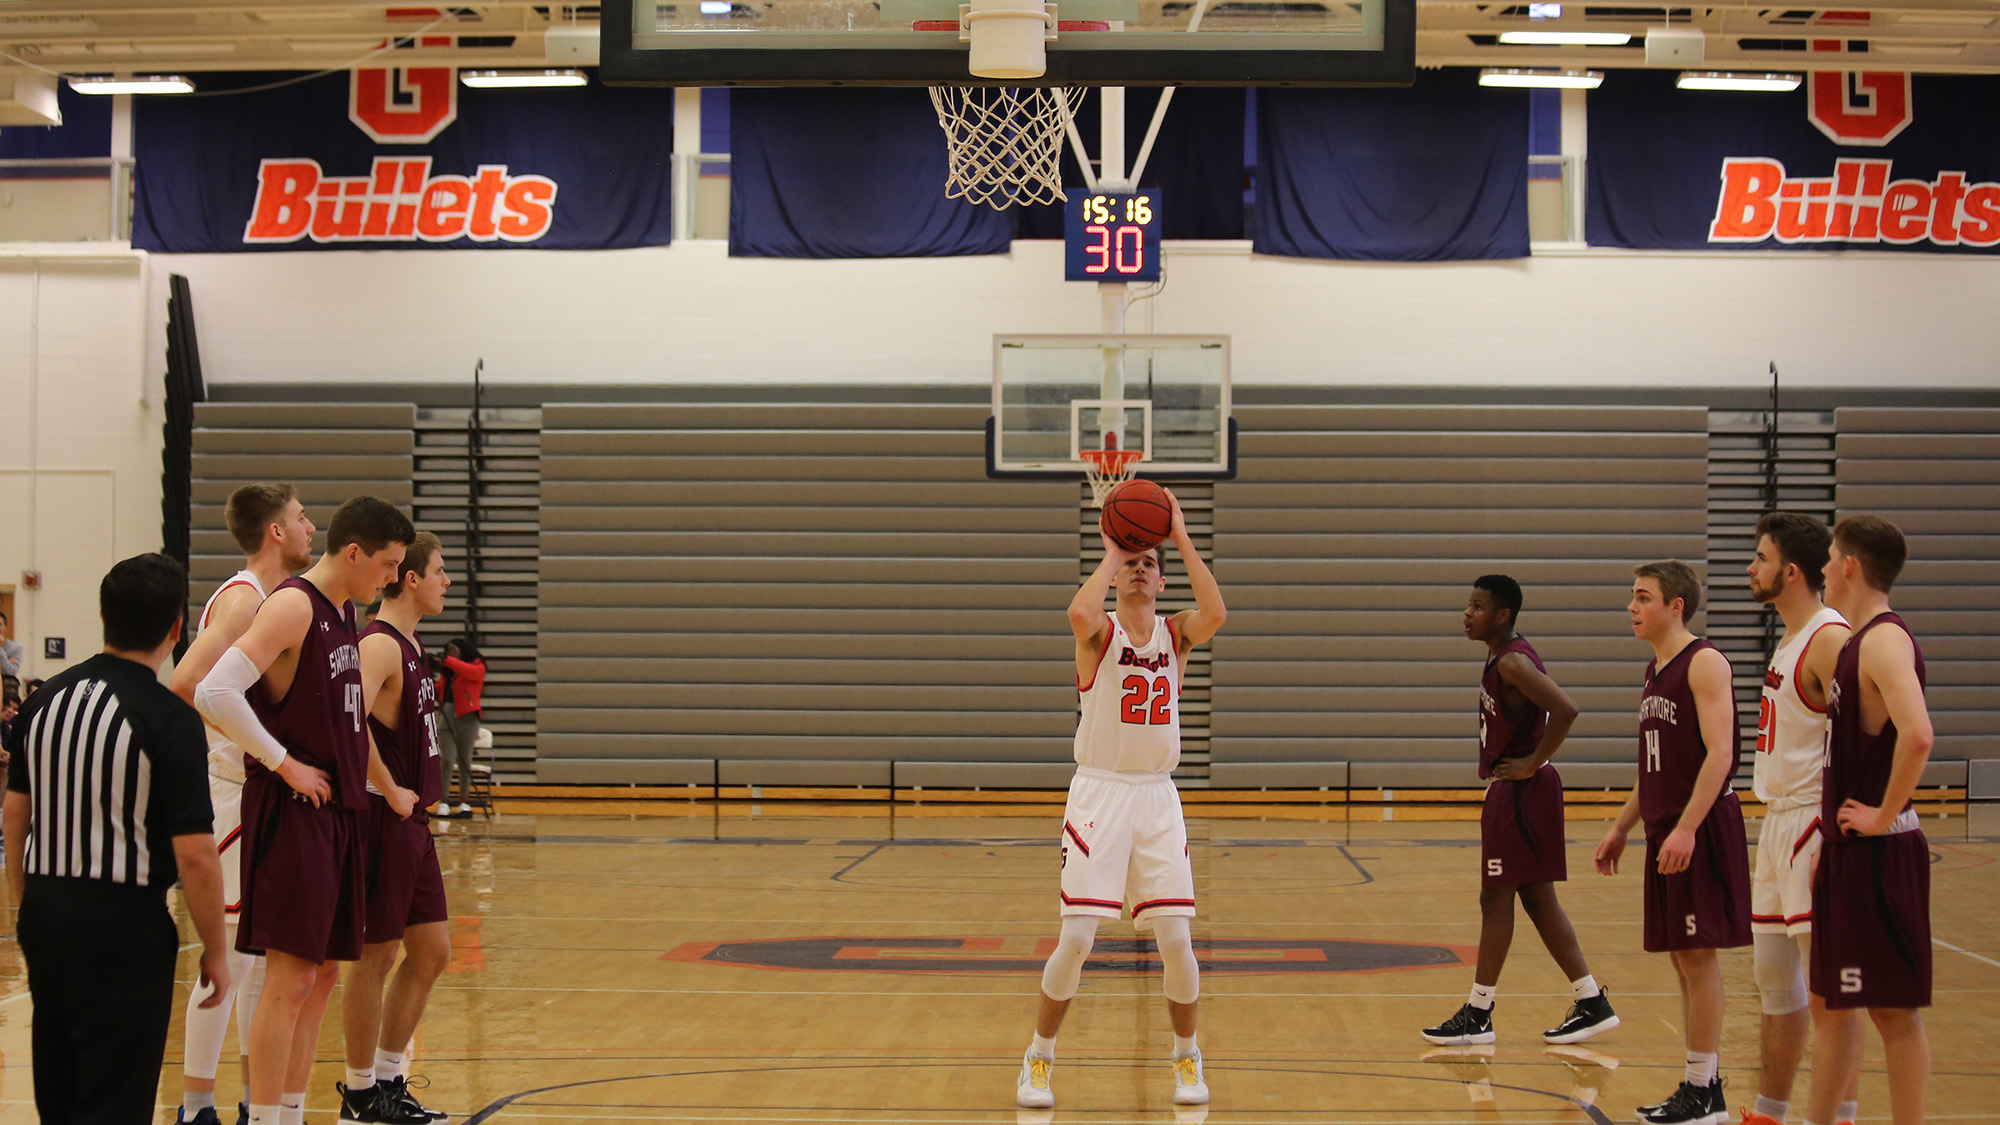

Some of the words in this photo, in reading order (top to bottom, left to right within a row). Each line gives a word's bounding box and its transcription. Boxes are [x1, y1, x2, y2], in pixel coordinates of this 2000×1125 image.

[243, 156, 558, 243] Bullets
[1083, 195, 1152, 225] 15:16
[1708, 157, 2000, 246] Bullets
[1084, 225, 1144, 274] 30
[344, 683, 361, 732] 40
[1120, 674, 1171, 725] 22
[1645, 729, 1661, 773] 14
[1487, 858, 1503, 877] S
[1685, 914, 1697, 936] S
[1840, 968, 1863, 993] S
